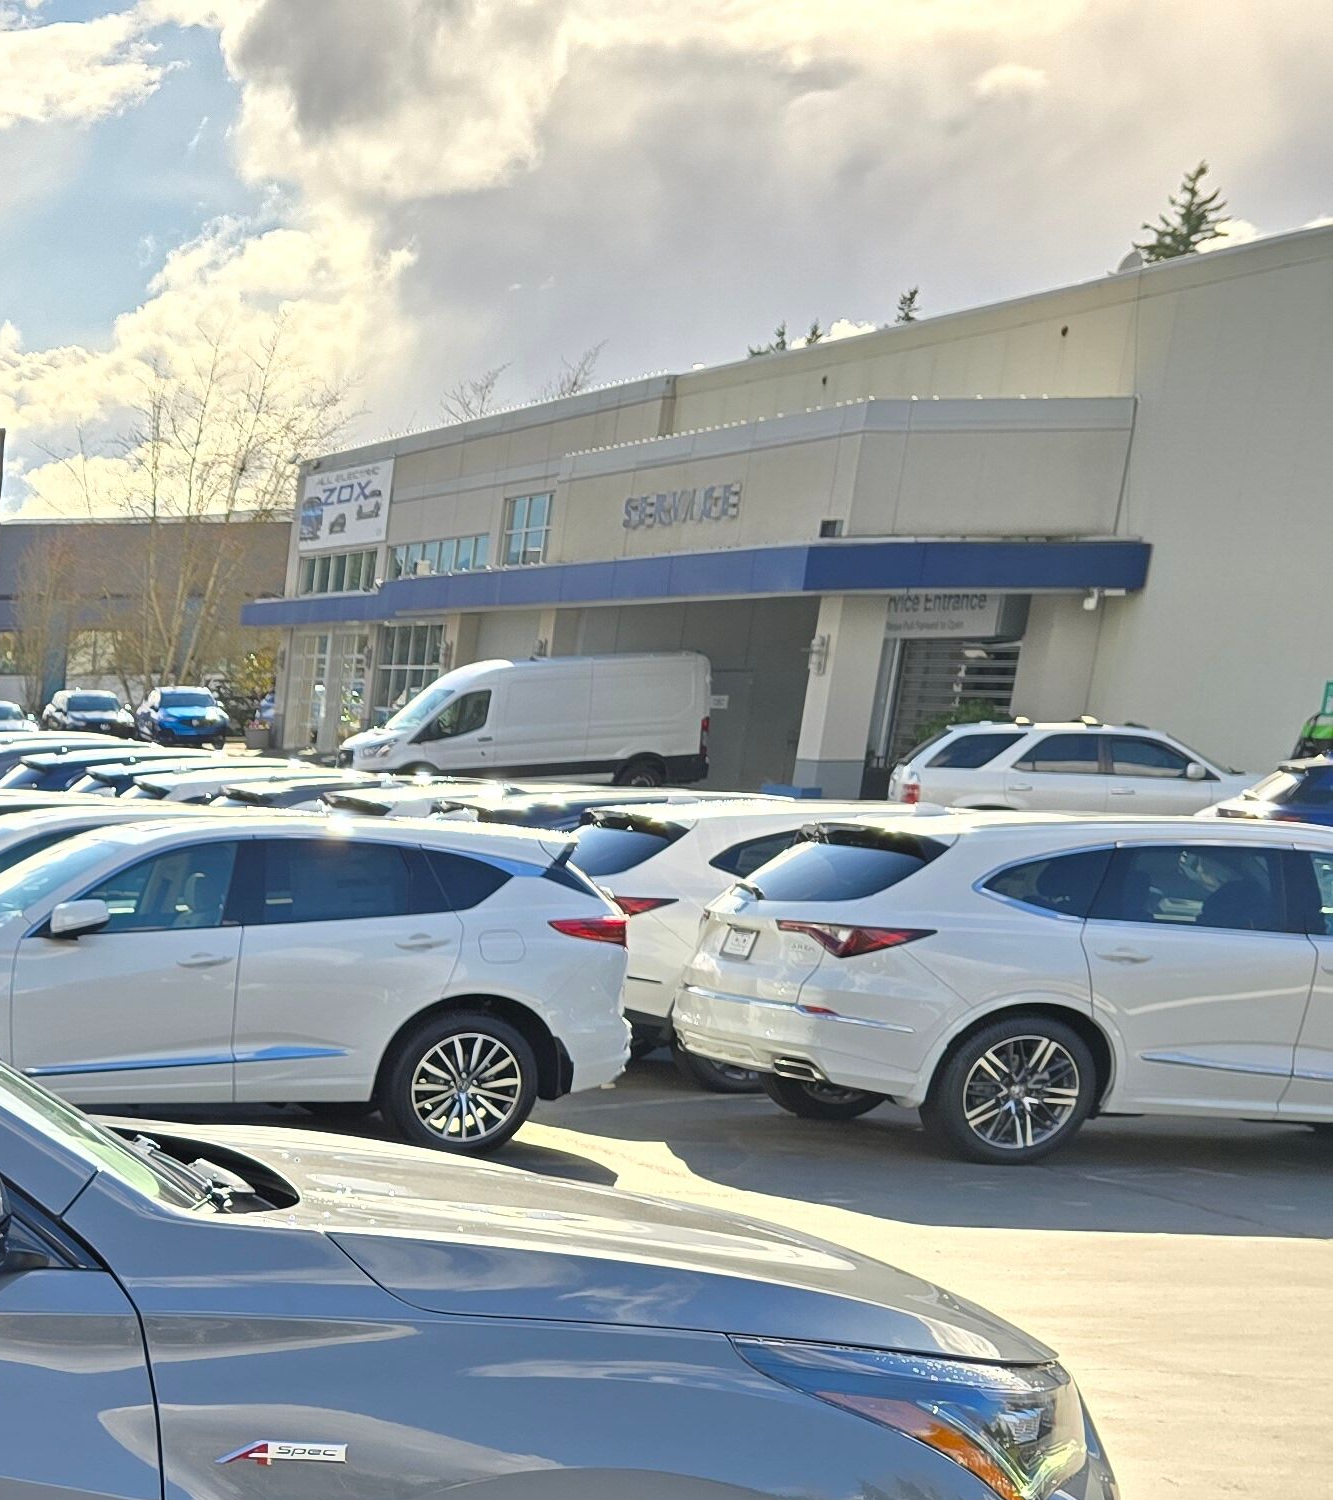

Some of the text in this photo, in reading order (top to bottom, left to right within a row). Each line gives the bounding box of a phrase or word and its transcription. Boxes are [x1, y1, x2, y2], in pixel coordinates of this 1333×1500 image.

[622, 482, 743, 529] SERVICE
[887, 593, 988, 613] rvice Entrance
[275, 1444, 338, 1457] Spec
